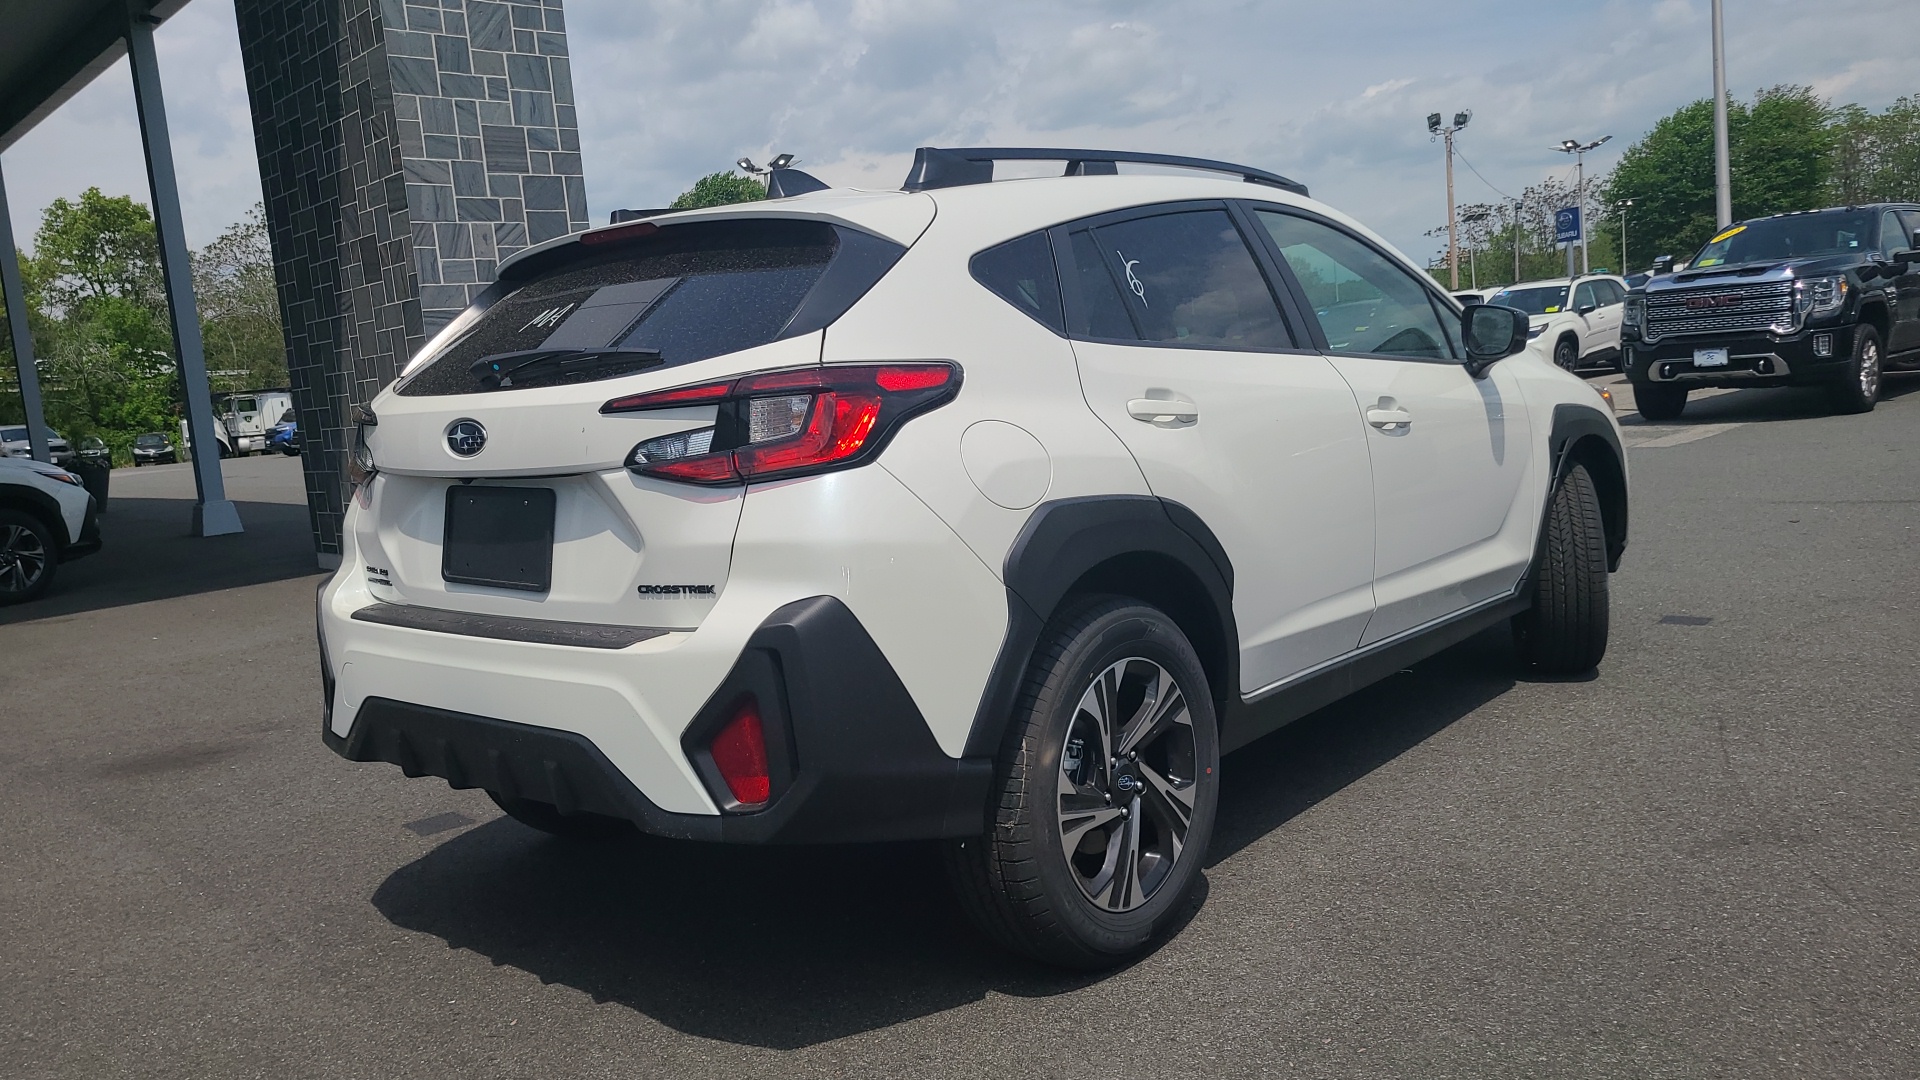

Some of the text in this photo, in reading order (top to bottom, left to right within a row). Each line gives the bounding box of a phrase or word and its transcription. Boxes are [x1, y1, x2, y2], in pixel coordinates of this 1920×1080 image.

[1556, 230, 1578, 240] SUBARU
[1686, 295, 1742, 309] GMC
[637, 584, 717, 595] CROSSTREK
